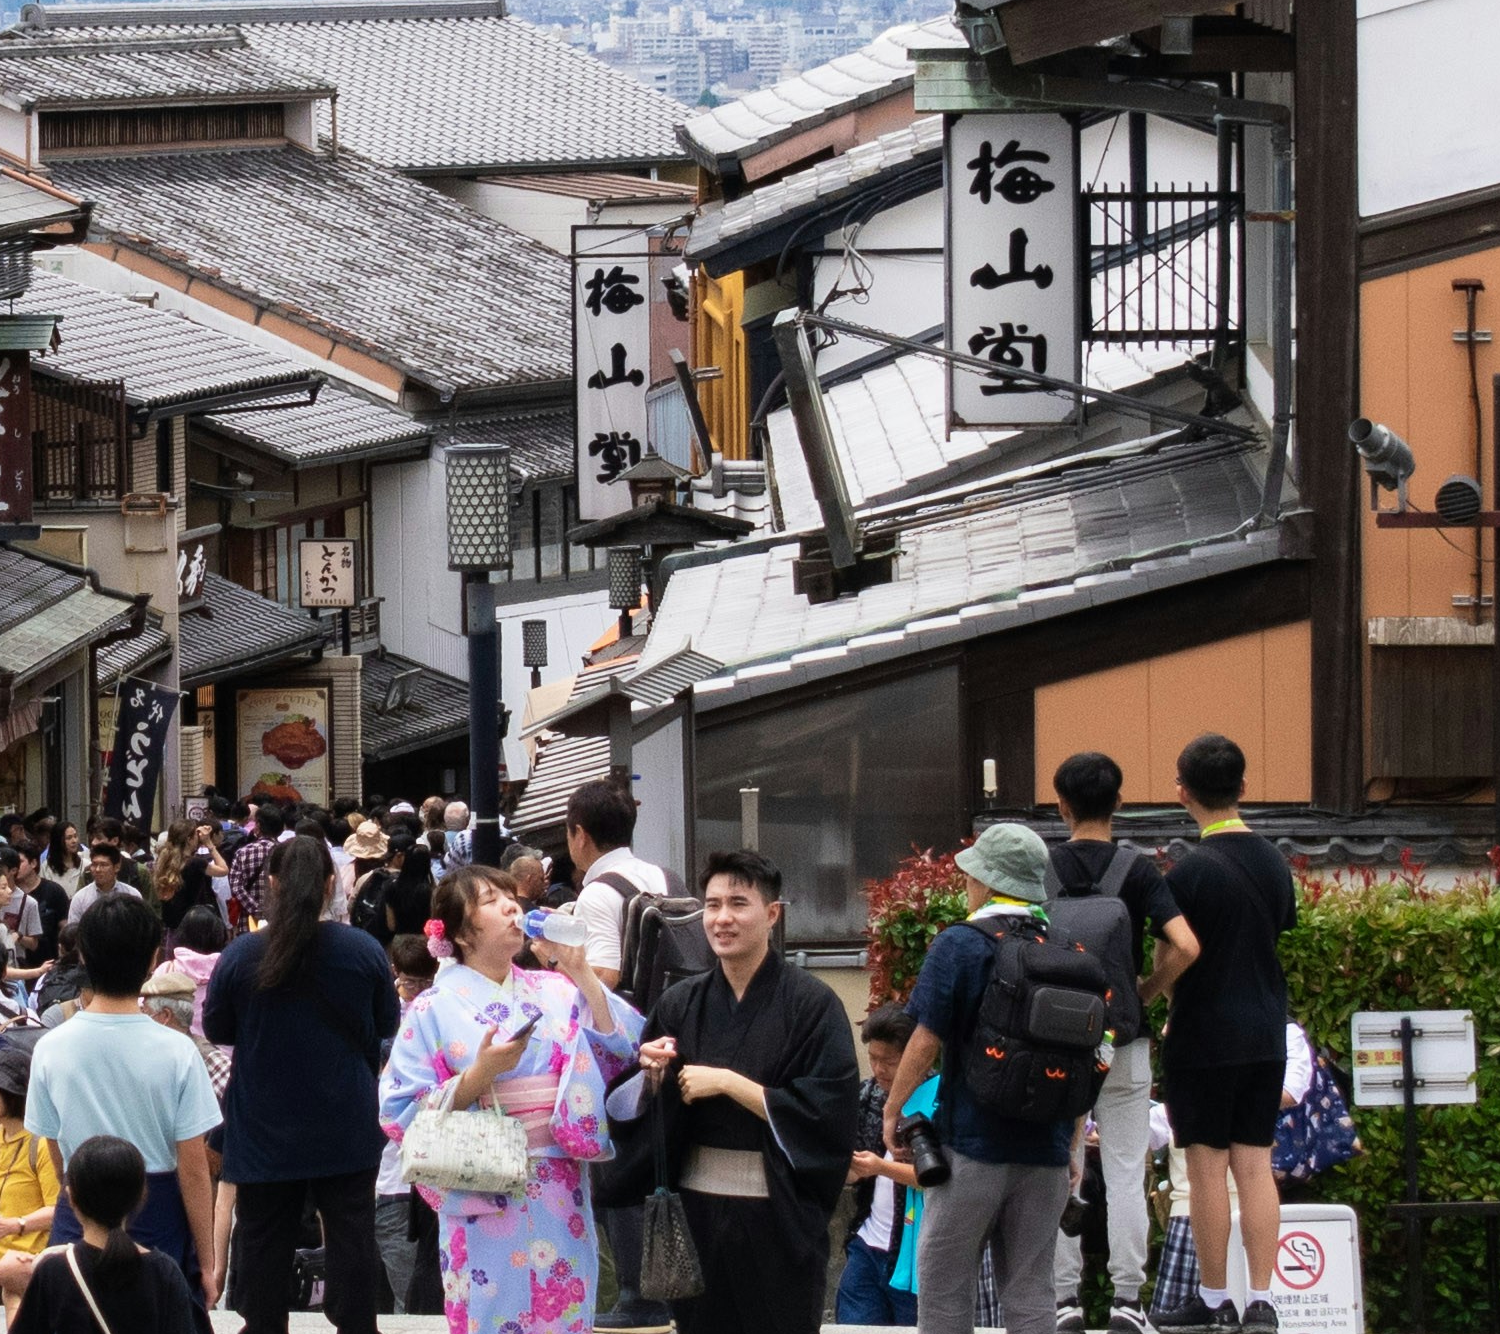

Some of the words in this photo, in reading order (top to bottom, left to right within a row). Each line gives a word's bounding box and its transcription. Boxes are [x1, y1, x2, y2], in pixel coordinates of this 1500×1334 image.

[966, 139, 1055, 397] 梅山堂
[584, 266, 645, 485] 梅山堂
[319, 544, 338, 597] とんかつ
[1282, 1319, 1329, 1329] Nonsmoking
[1330, 1319, 1348, 1328] Area
